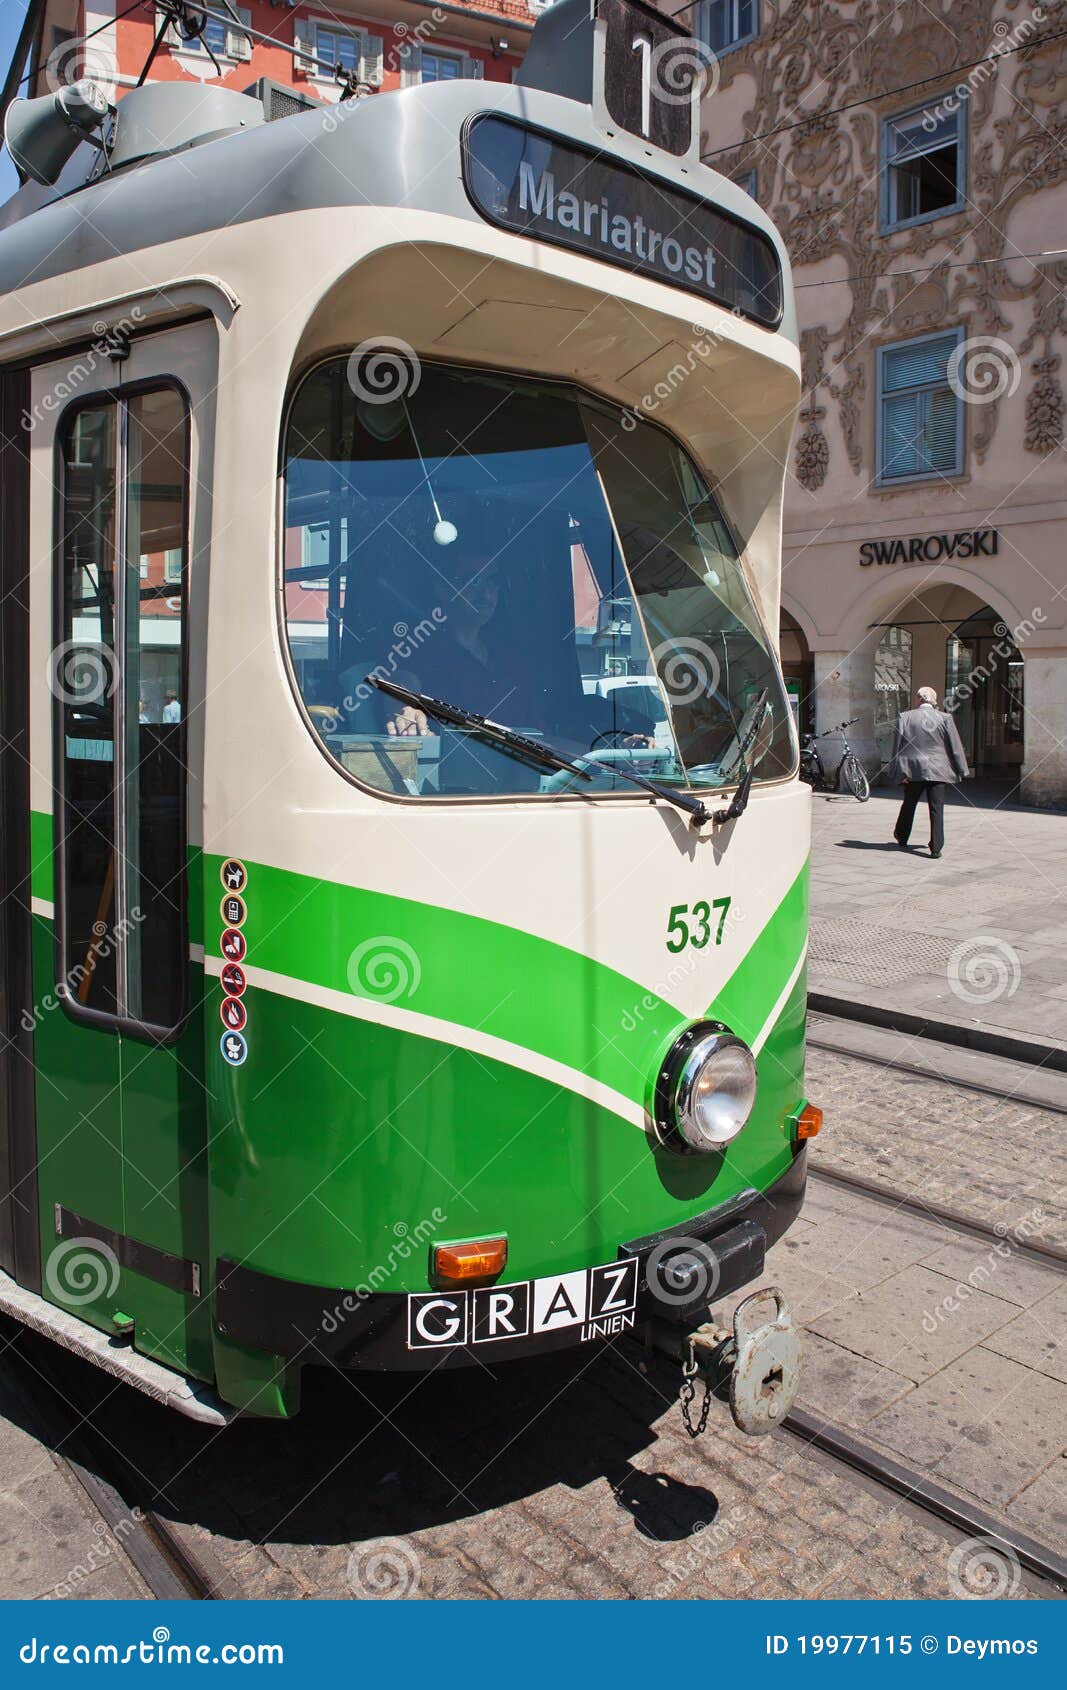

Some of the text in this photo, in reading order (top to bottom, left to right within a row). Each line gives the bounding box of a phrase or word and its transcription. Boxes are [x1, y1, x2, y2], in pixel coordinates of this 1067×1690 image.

[632, 37, 651, 137] 1
[518, 160, 716, 289] Mariatrost
[859, 529, 1000, 567] SWAROVSKI
[666, 896, 732, 954] 537
[415, 1267, 628, 1342] GRAZ
[580, 1311, 635, 1342] LINIEN
